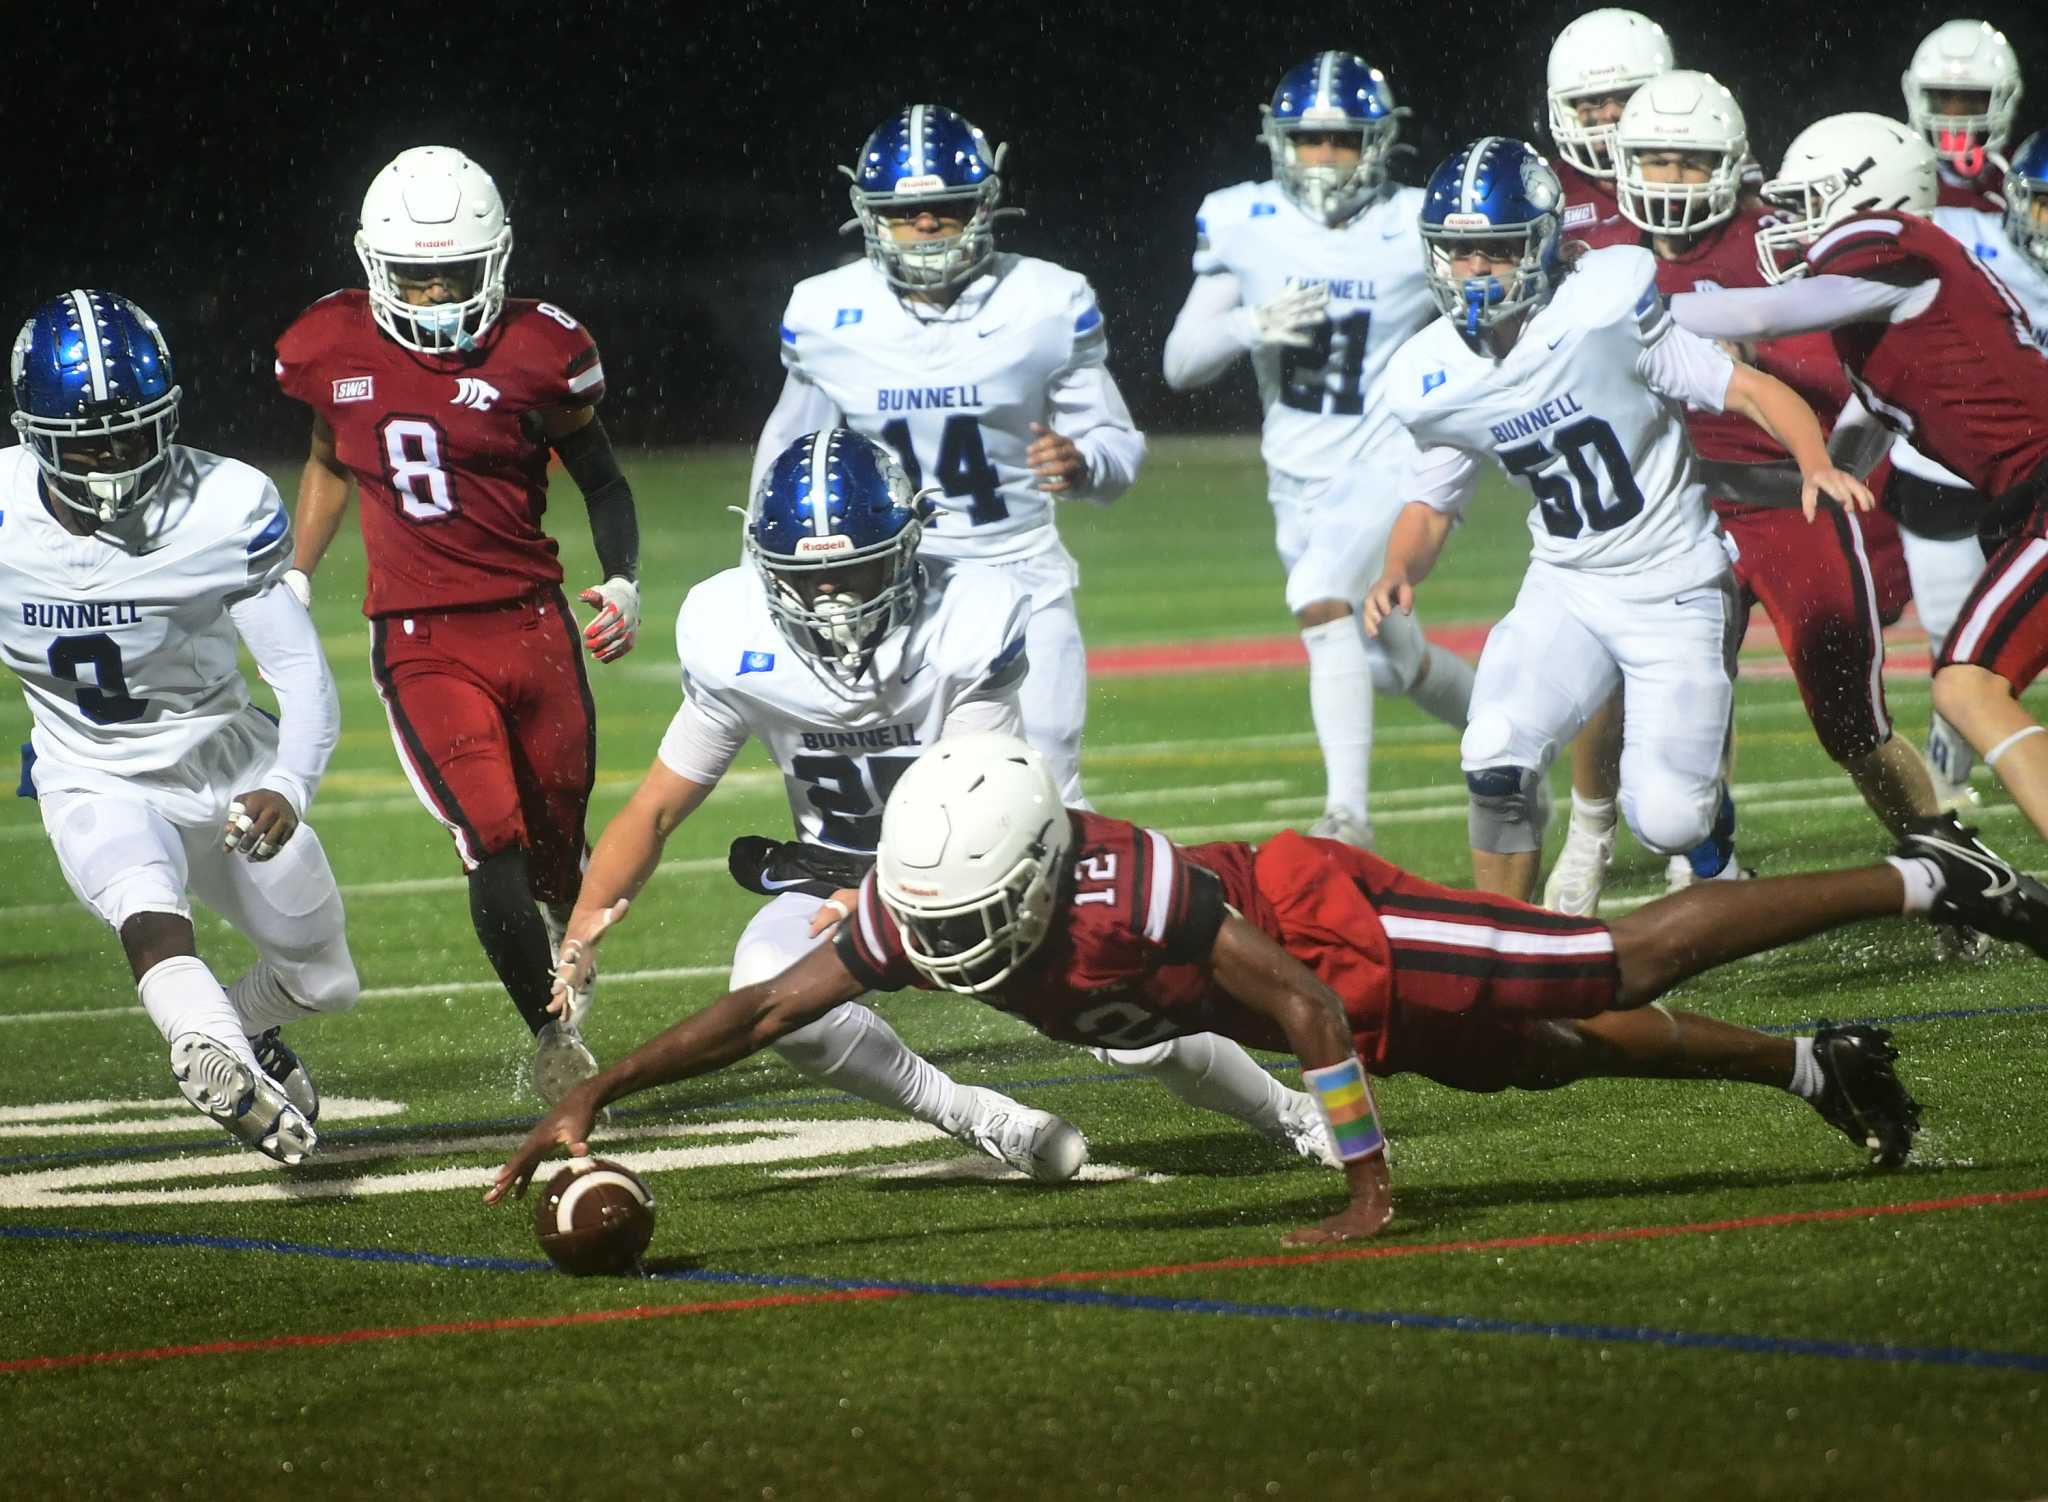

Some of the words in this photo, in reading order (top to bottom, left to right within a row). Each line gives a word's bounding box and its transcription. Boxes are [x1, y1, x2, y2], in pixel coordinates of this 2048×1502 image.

[536, 302, 577, 330] 8
[337, 380, 368, 398] SWC
[877, 384, 983, 412] BUNNELL
[1489, 392, 1583, 443] BUNNELL
[381, 416, 458, 522] 8
[880, 413, 1010, 528] 14
[1496, 414, 1645, 540] 50
[802, 539, 846, 551] Riddell
[21, 600, 142, 629] BUNNELL
[800, 723, 922, 751] BUNNELL
[1074, 853, 1118, 906] 12
